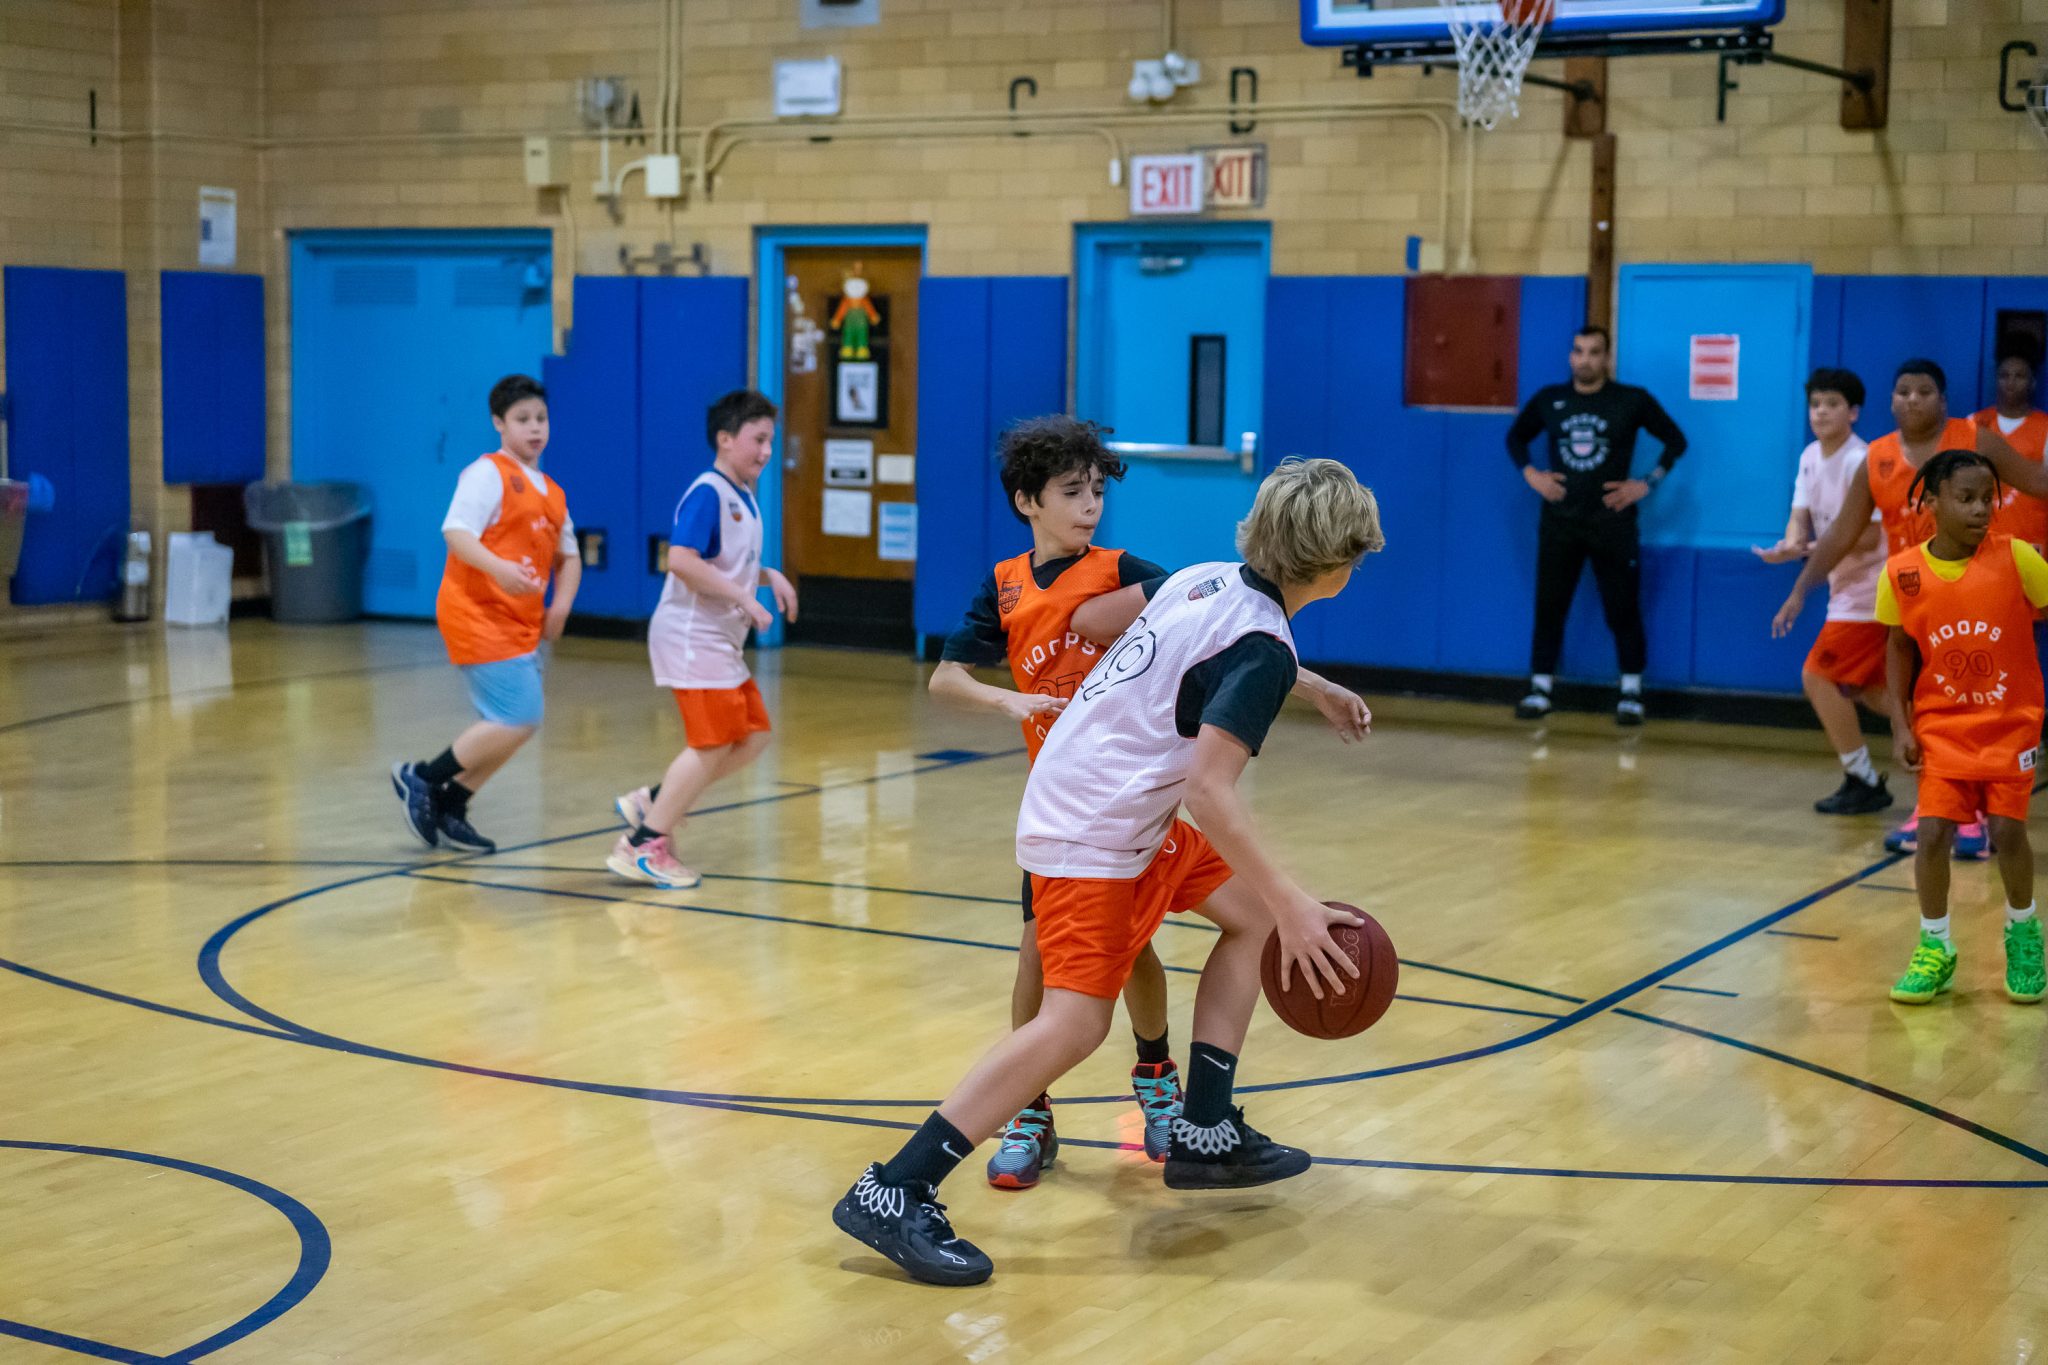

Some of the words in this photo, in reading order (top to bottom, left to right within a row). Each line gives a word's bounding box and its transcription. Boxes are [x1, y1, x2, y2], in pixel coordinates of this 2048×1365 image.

[1142, 163, 1194, 208] EXIT
[1929, 620, 2002, 648] HOOPS
[1944, 649, 1995, 680] 90
[1934, 669, 2009, 706] ACADEMY
